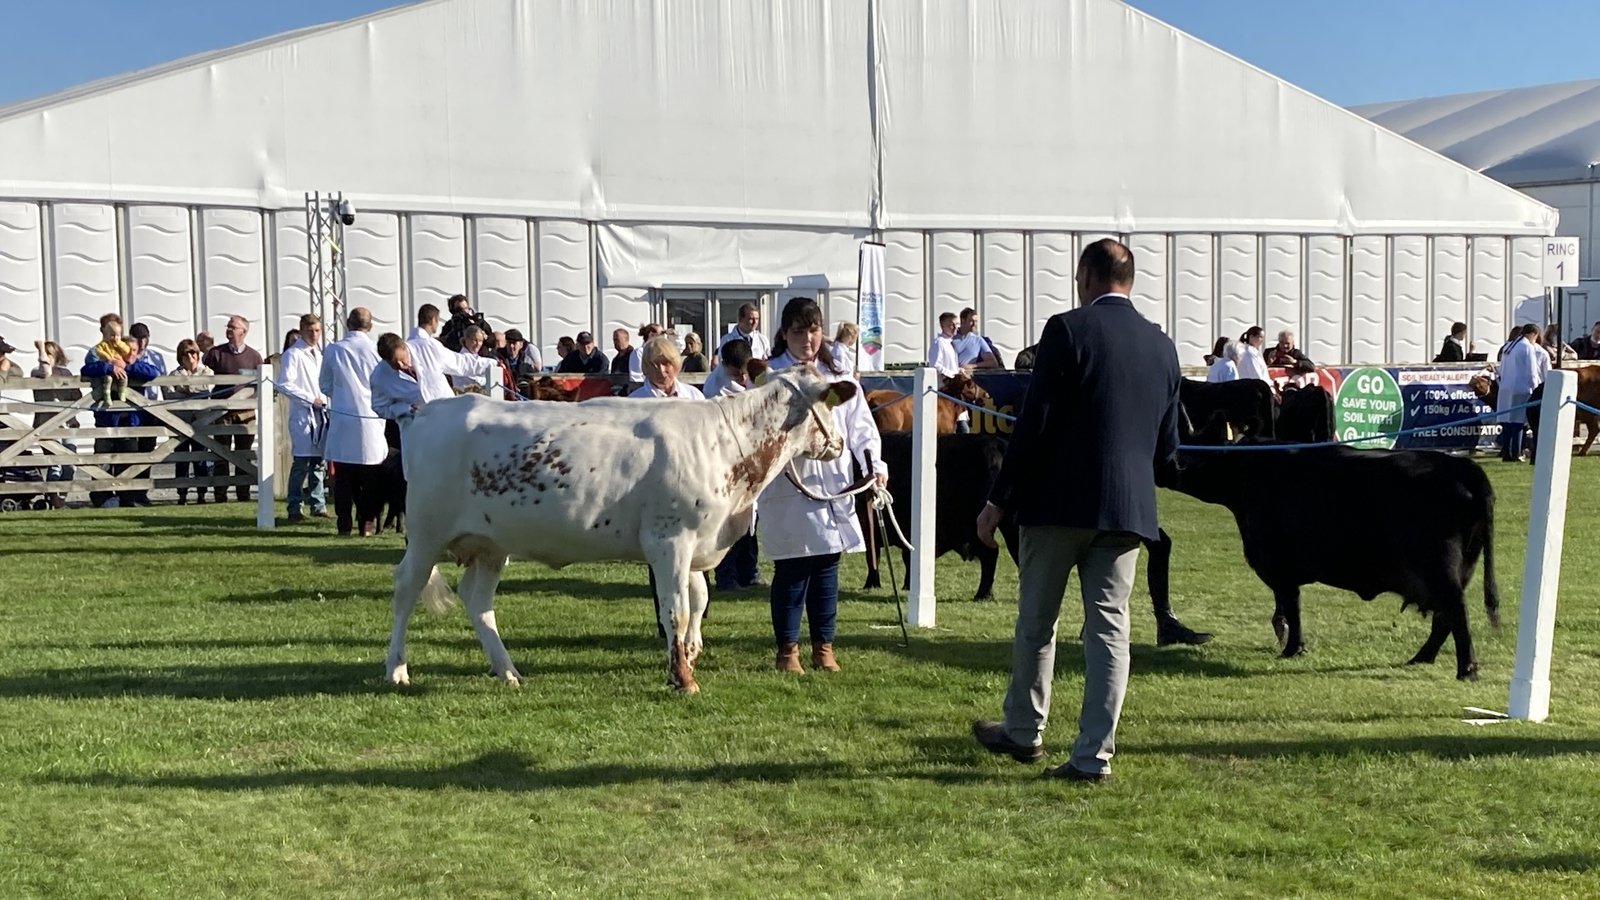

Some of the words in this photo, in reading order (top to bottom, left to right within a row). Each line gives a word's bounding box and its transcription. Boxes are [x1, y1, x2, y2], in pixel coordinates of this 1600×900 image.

[1547, 243, 1576, 255] RING
[1556, 261, 1564, 280] 1
[1419, 373, 1446, 382] HEALTH
[1447, 373, 1468, 382] ALERT
[1357, 374, 1385, 395] GO
[1424, 390, 1449, 400] 100%
[1341, 397, 1367, 409] SAVE
[1369, 399, 1397, 411] YOUR
[1423, 404, 1450, 416] 150kg
[1457, 404, 1470, 414] Ac
[1343, 412, 1366, 423] SOIL
[1367, 413, 1393, 425] WITH
[1440, 425, 1503, 437] CONSULTATIO
